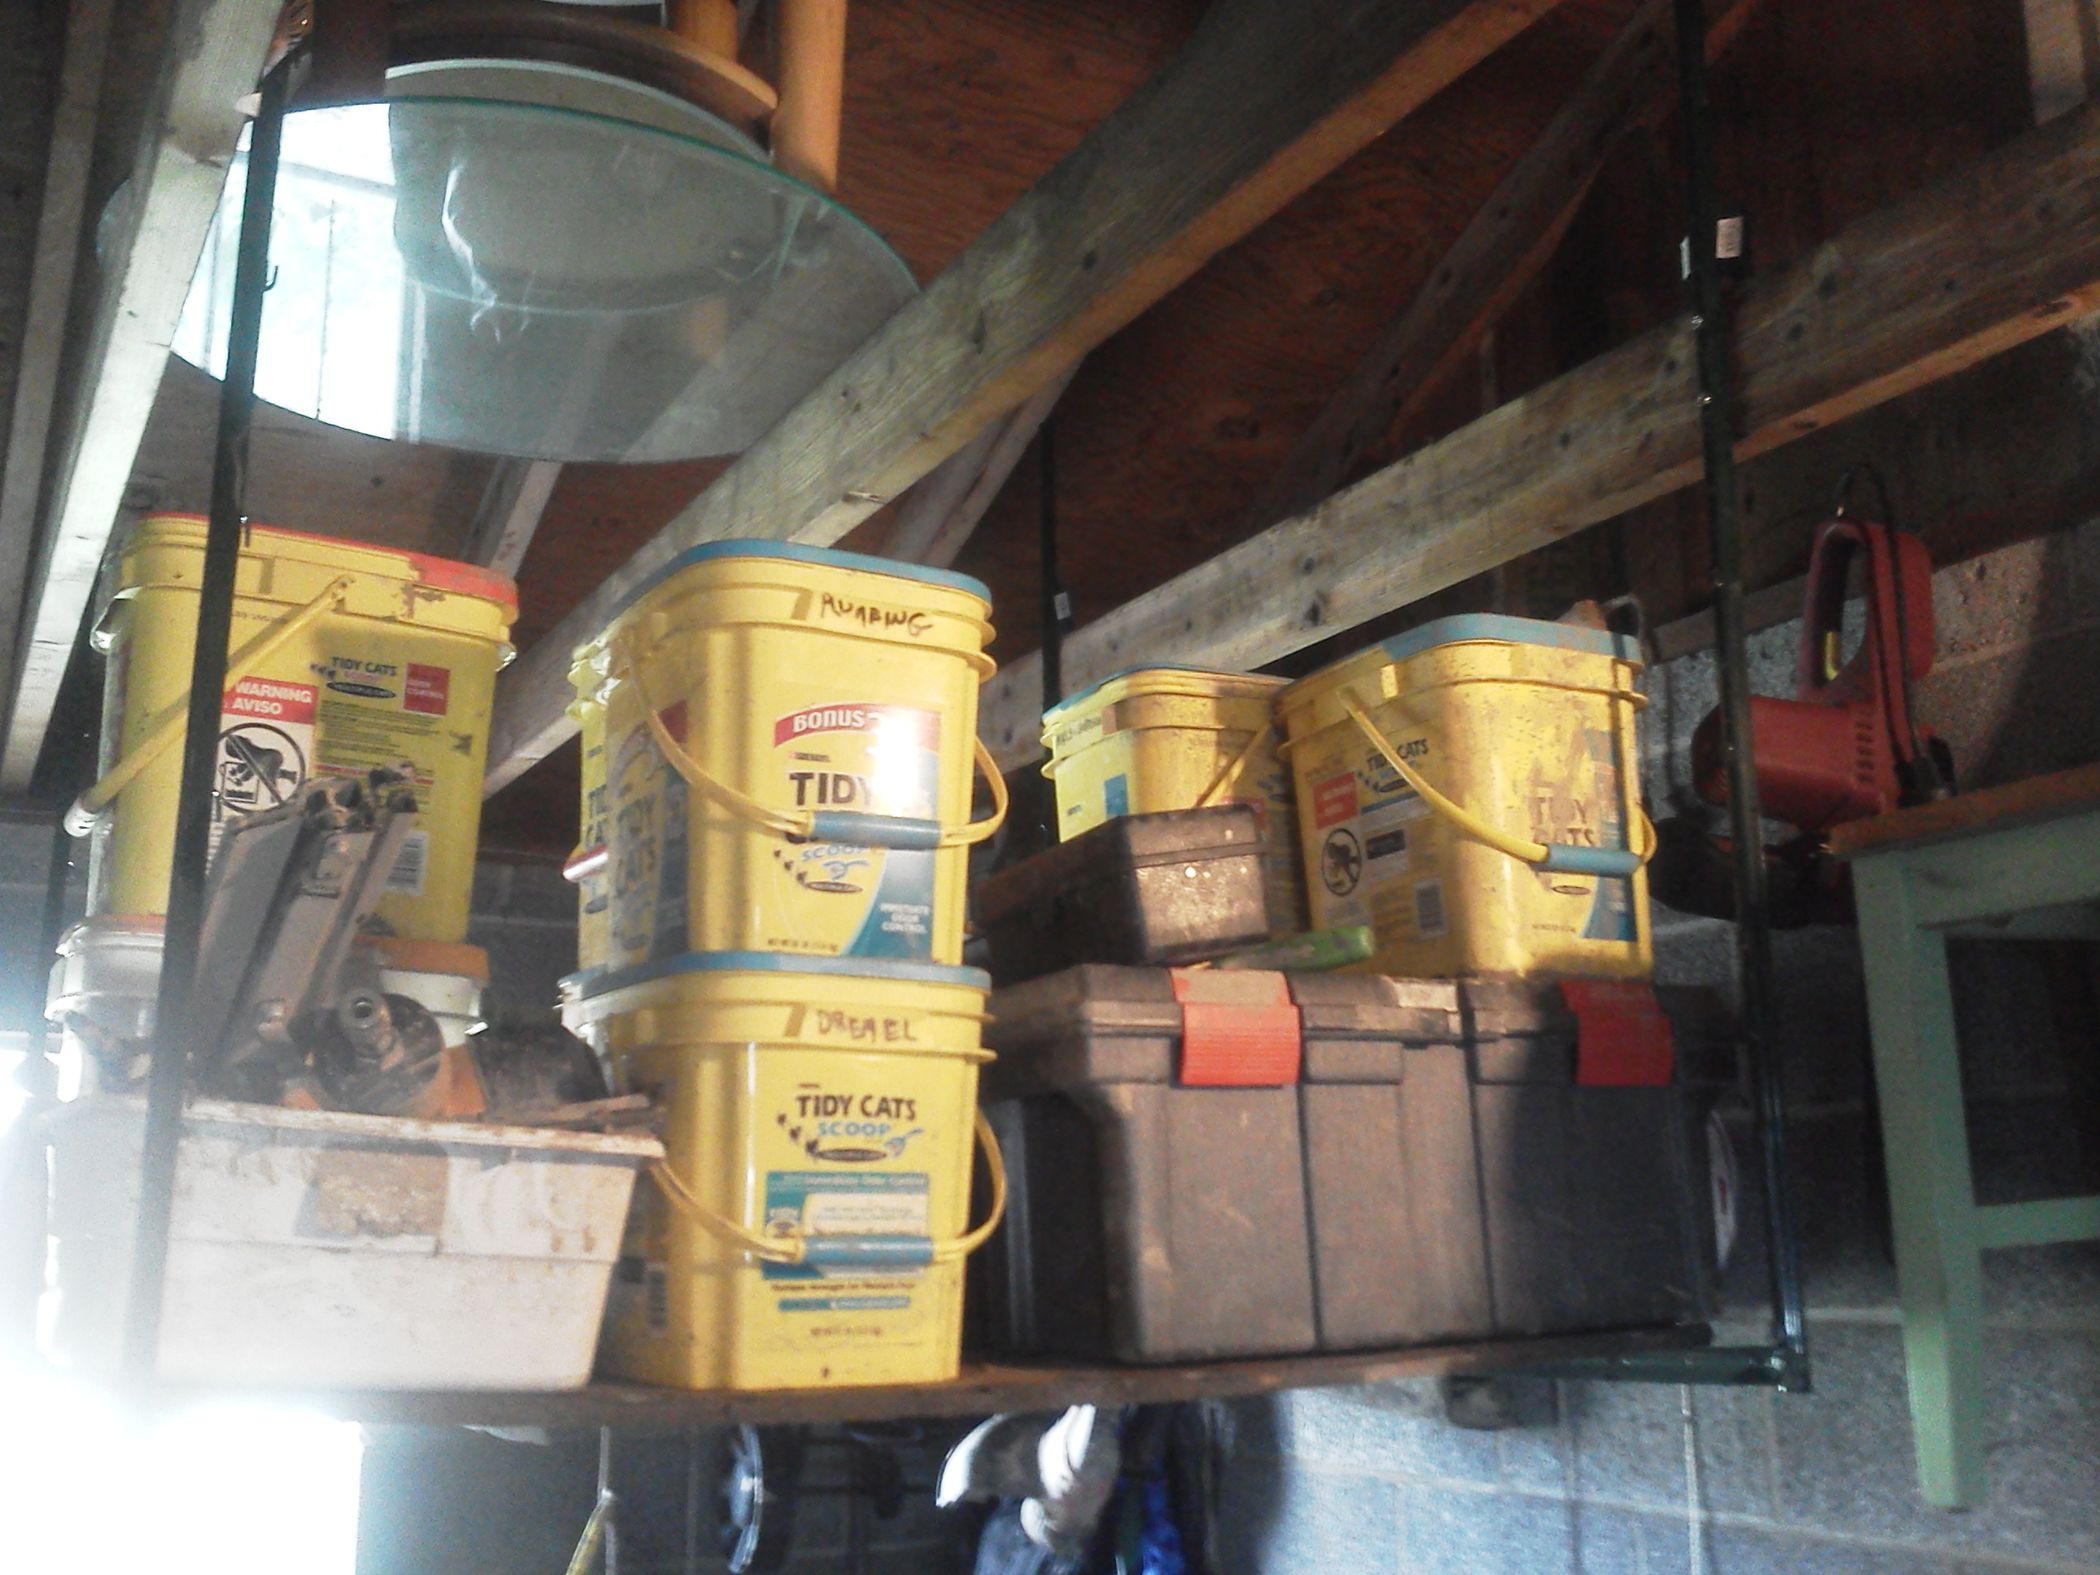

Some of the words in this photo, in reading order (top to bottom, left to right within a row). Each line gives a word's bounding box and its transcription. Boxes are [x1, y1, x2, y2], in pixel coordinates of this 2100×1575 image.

[331, 656, 362, 671] TIDY
[365, 661, 397, 676] CATS
[236, 681, 312, 703] WARNING
[232, 697, 283, 715] AVISO
[793, 709, 865, 733] BONUS
[1397, 738, 1429, 759] CATS
[797, 1095, 853, 1117] TIDY
[860, 1095, 916, 1121] CATS
[818, 1122, 890, 1137] SCOOP
